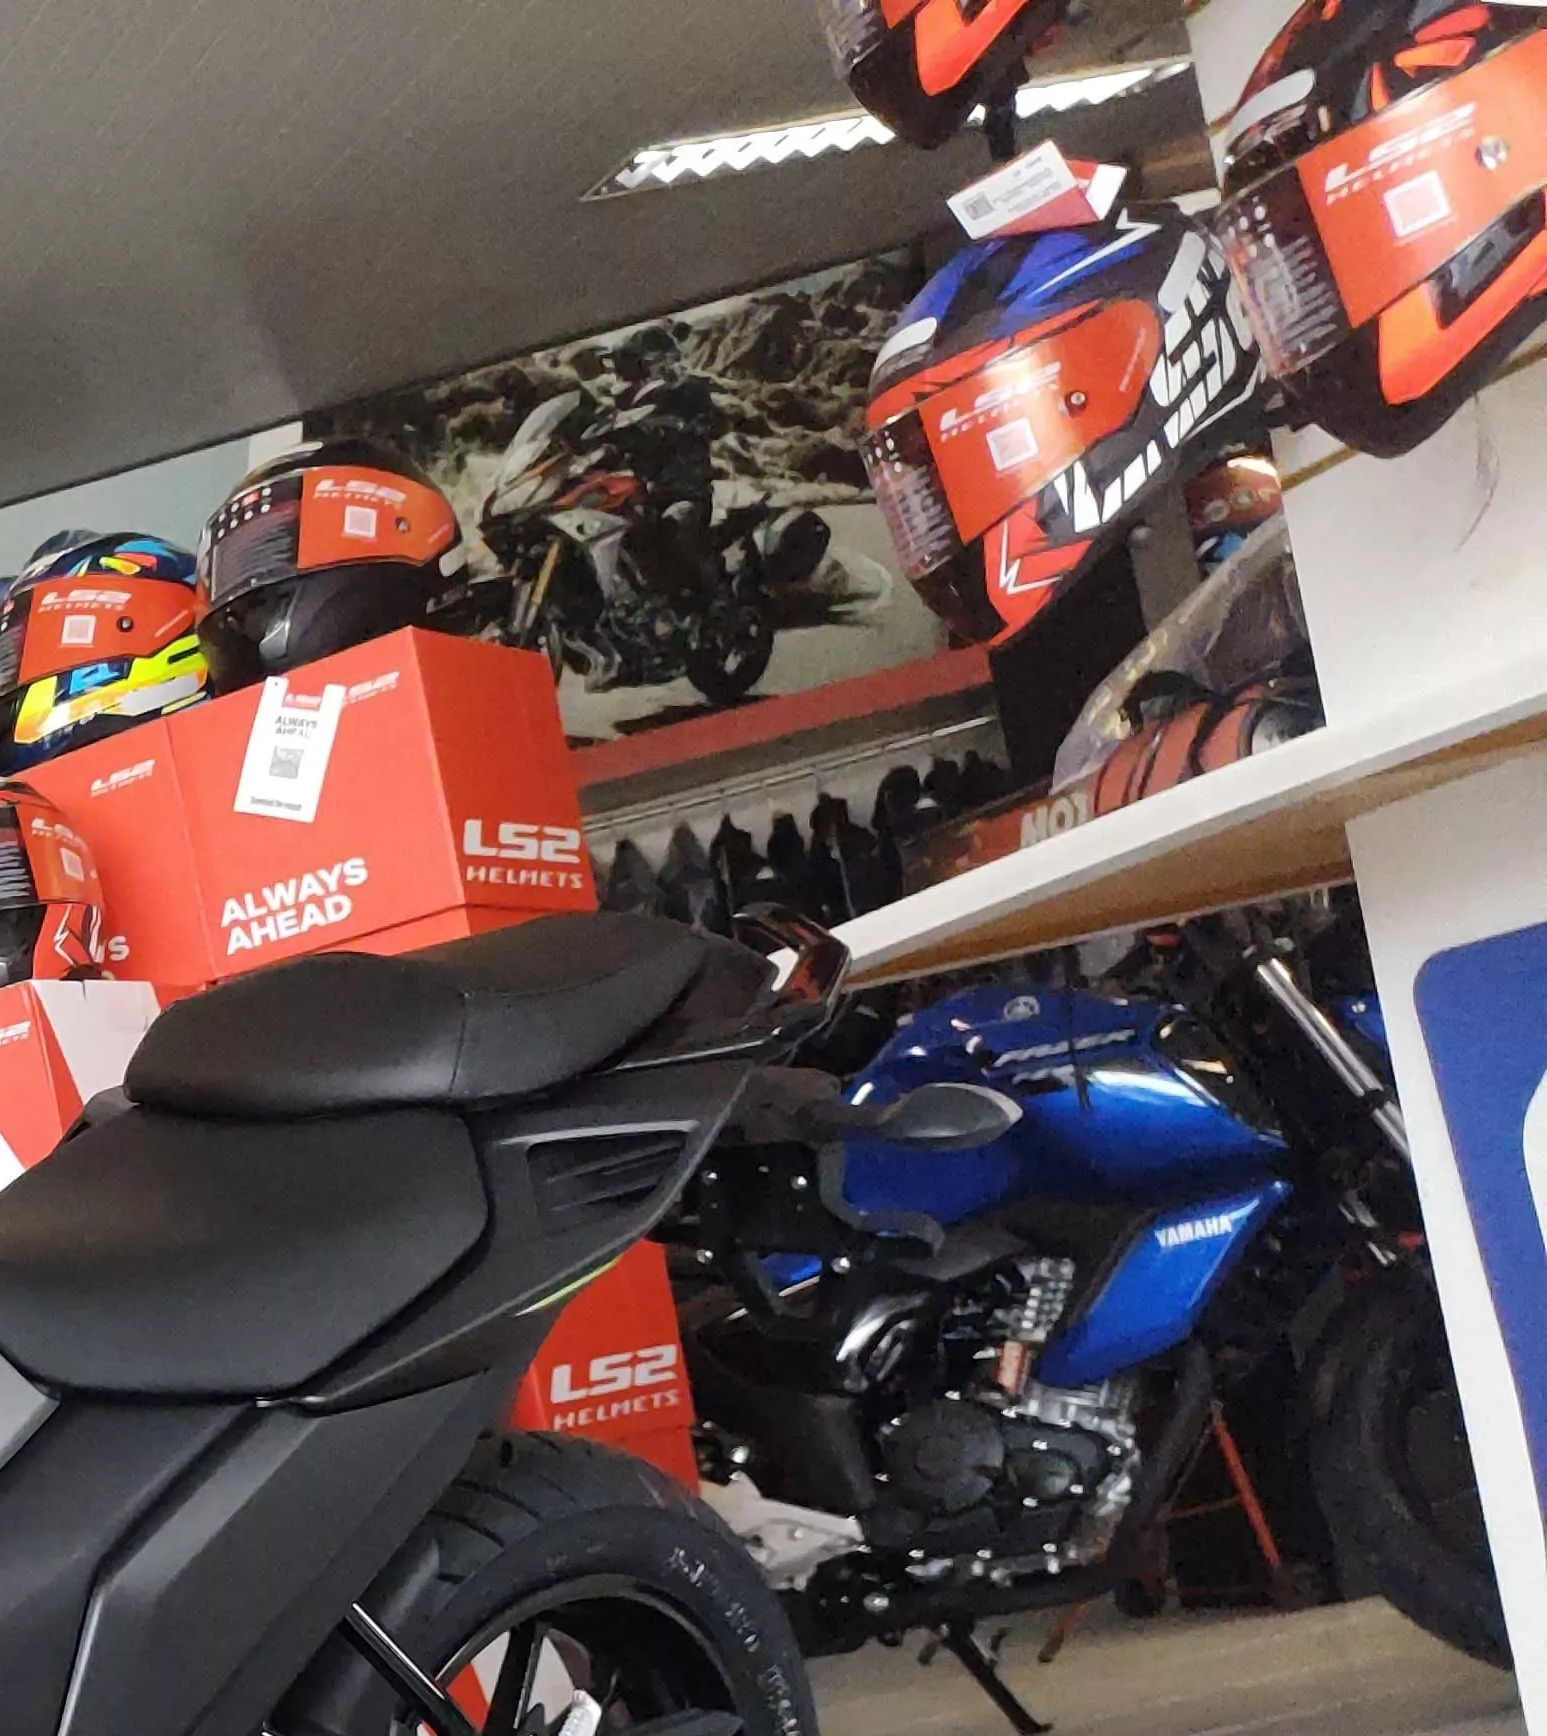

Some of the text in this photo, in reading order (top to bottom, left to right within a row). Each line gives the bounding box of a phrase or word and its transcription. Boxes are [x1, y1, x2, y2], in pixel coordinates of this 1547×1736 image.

[40, 589, 132, 605] LS2
[463, 818, 582, 865] LS2
[220, 856, 369, 929] ALWAYS
[466, 864, 585, 890] HELMETS
[225, 895, 353, 957] AHEAD
[1154, 1214, 1233, 1248] YAMAHA
[550, 1344, 678, 1405] LS2
[553, 1388, 680, 1432] HELMETS
